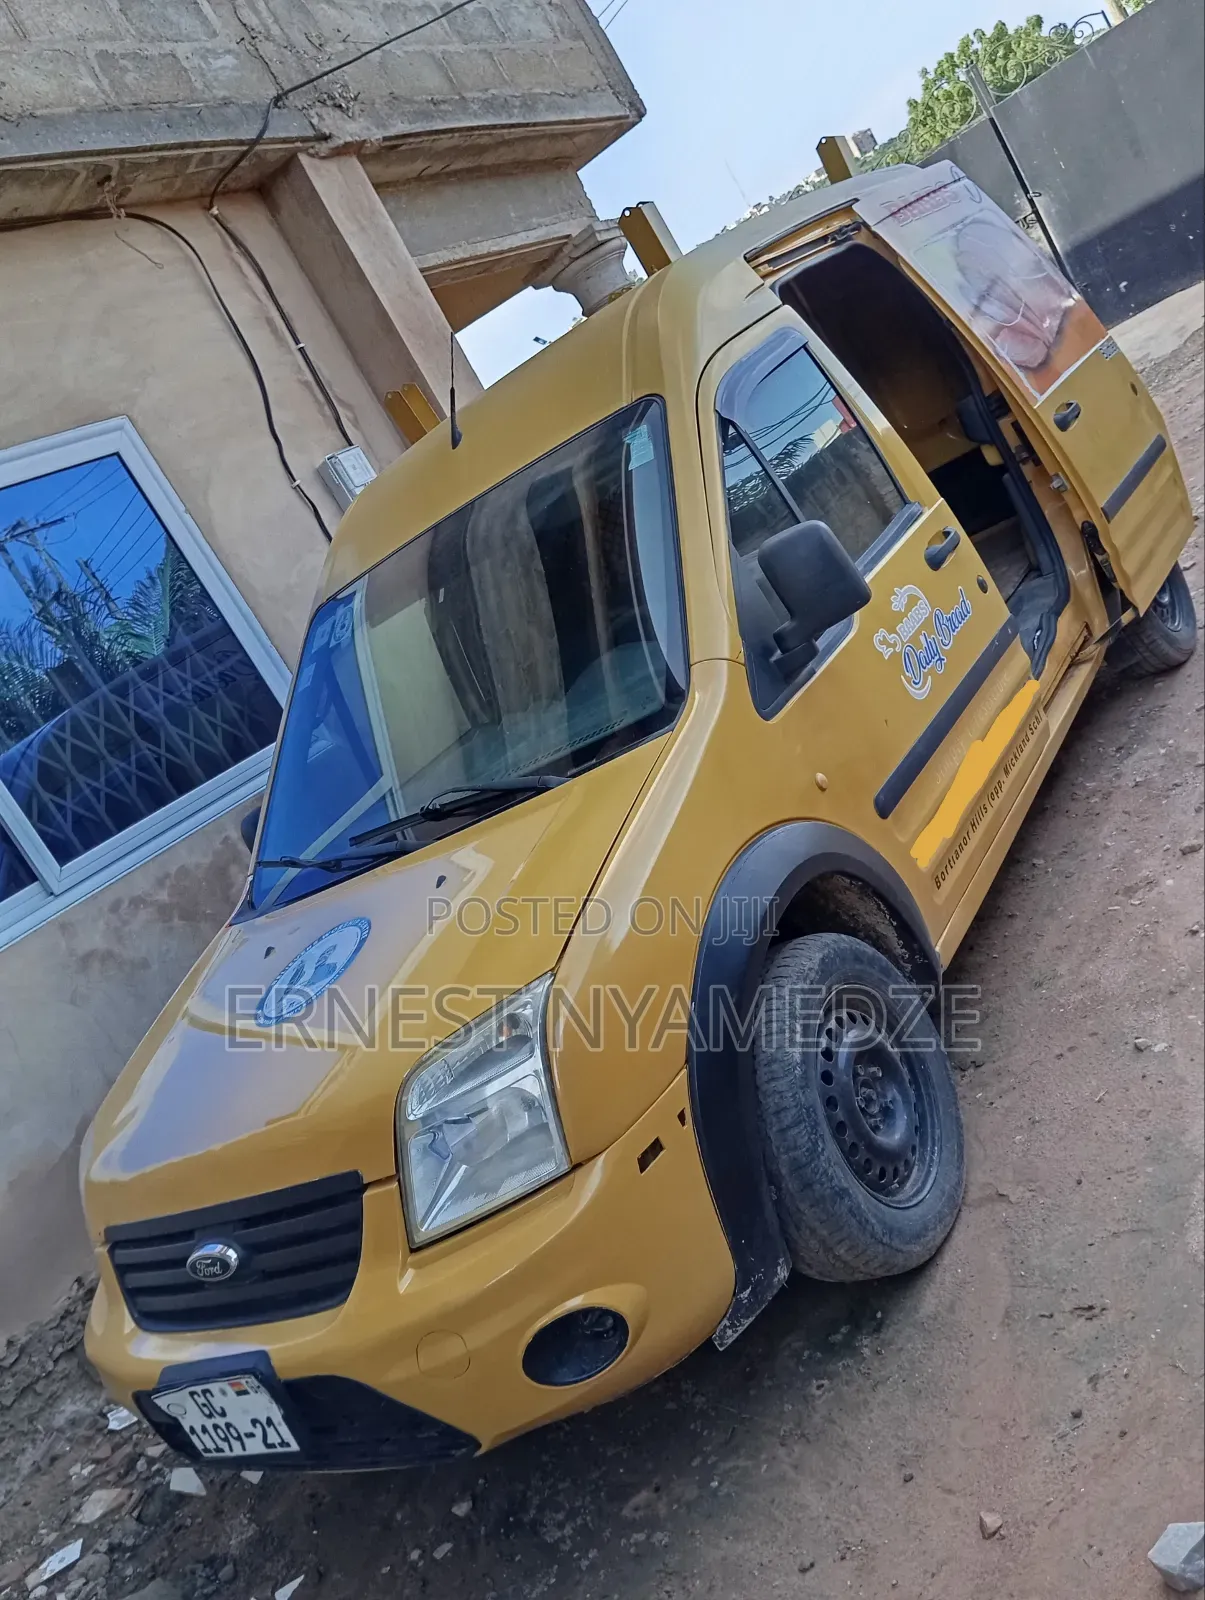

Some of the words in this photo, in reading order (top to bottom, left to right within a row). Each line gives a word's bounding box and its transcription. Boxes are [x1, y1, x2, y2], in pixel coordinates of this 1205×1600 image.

[896, 599, 930, 642] BAABS
[902, 630, 947, 687] Daily
[933, 586, 972, 649] Bread
[969, 803, 988, 834] Hills
[986, 779, 1006, 809] (opp.
[1003, 731, 1031, 779] Mickland
[195, 1259, 223, 1277] Ford
[188, 1388, 228, 1420] GC
[189, 1416, 292, 1455] 1199-21
